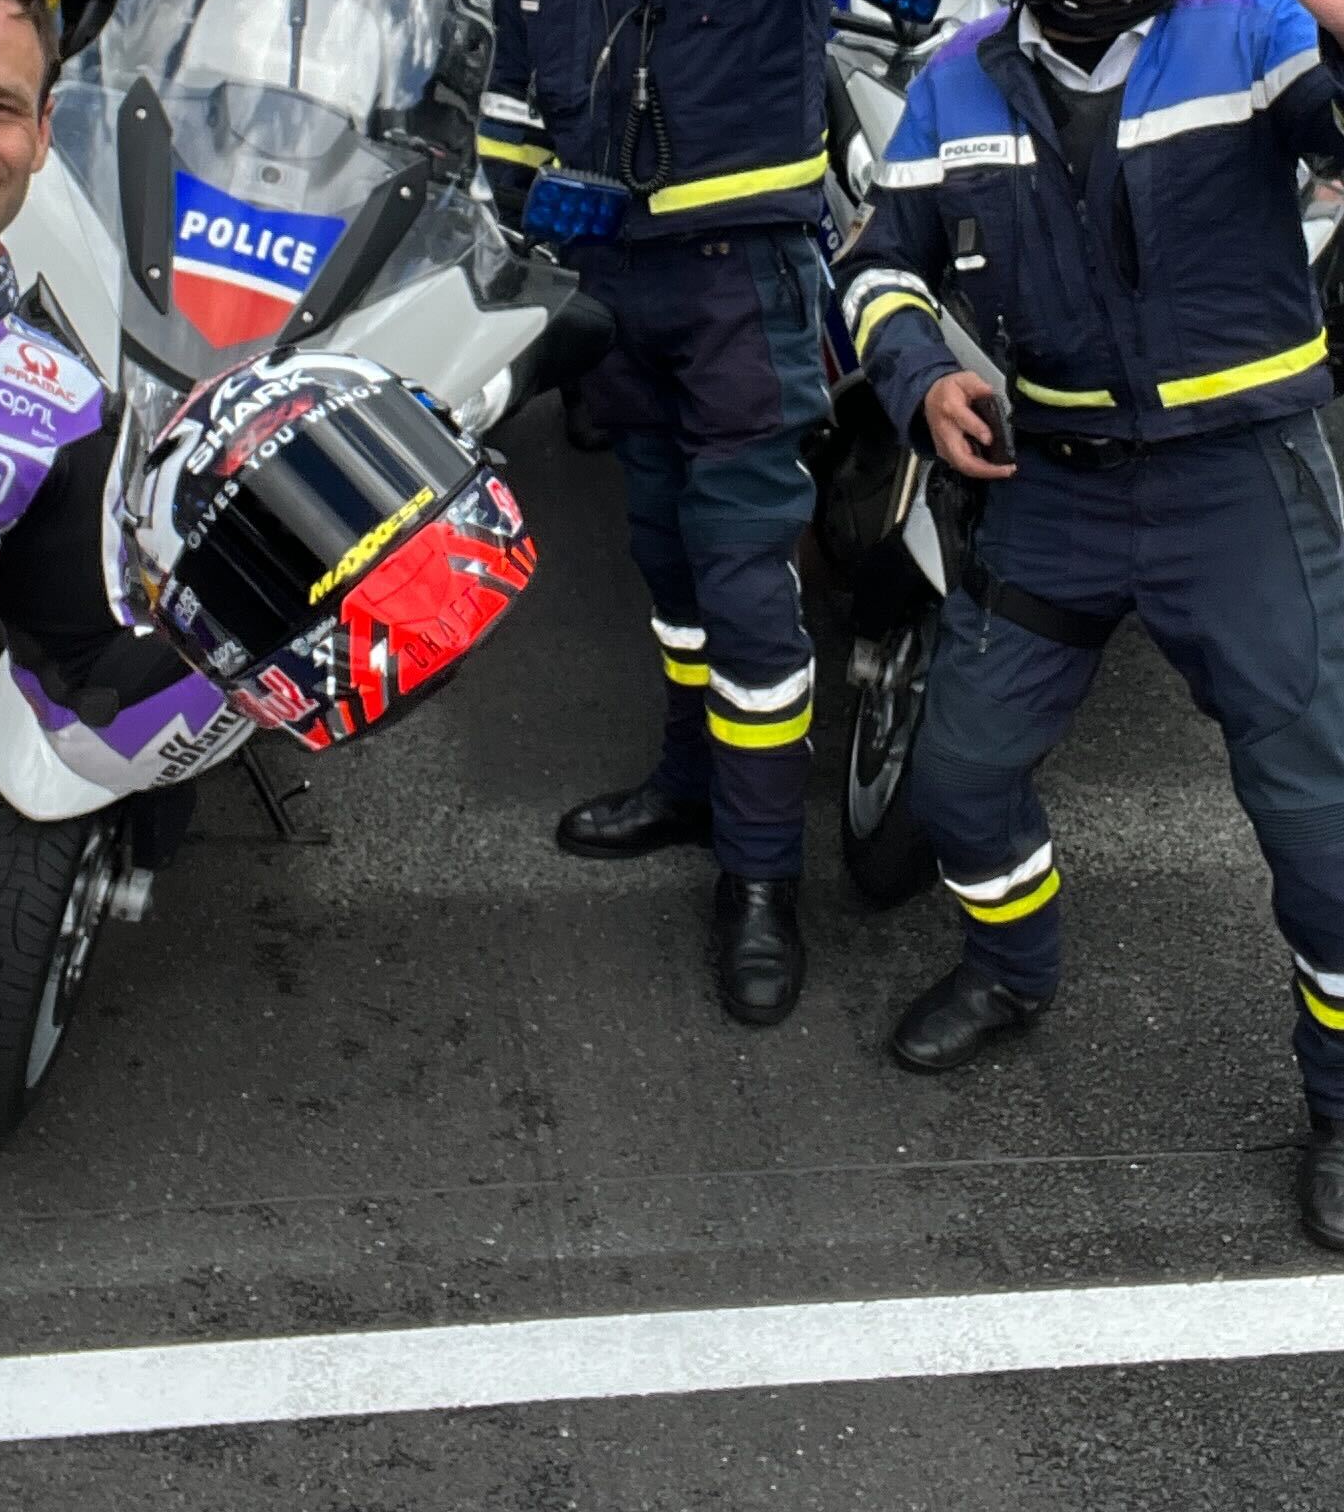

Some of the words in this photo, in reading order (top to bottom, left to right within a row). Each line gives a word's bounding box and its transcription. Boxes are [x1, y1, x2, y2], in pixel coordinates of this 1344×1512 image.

[944, 142, 1002, 157] POLICE
[179, 209, 318, 277] POLICE
[3, 365, 77, 403] PRAMAC
[186, 368, 315, 476] SHARK
[244, 424, 296, 471] YOU
[302, 382, 383, 424] WINGS
[309, 486, 436, 606] MAXXESS
